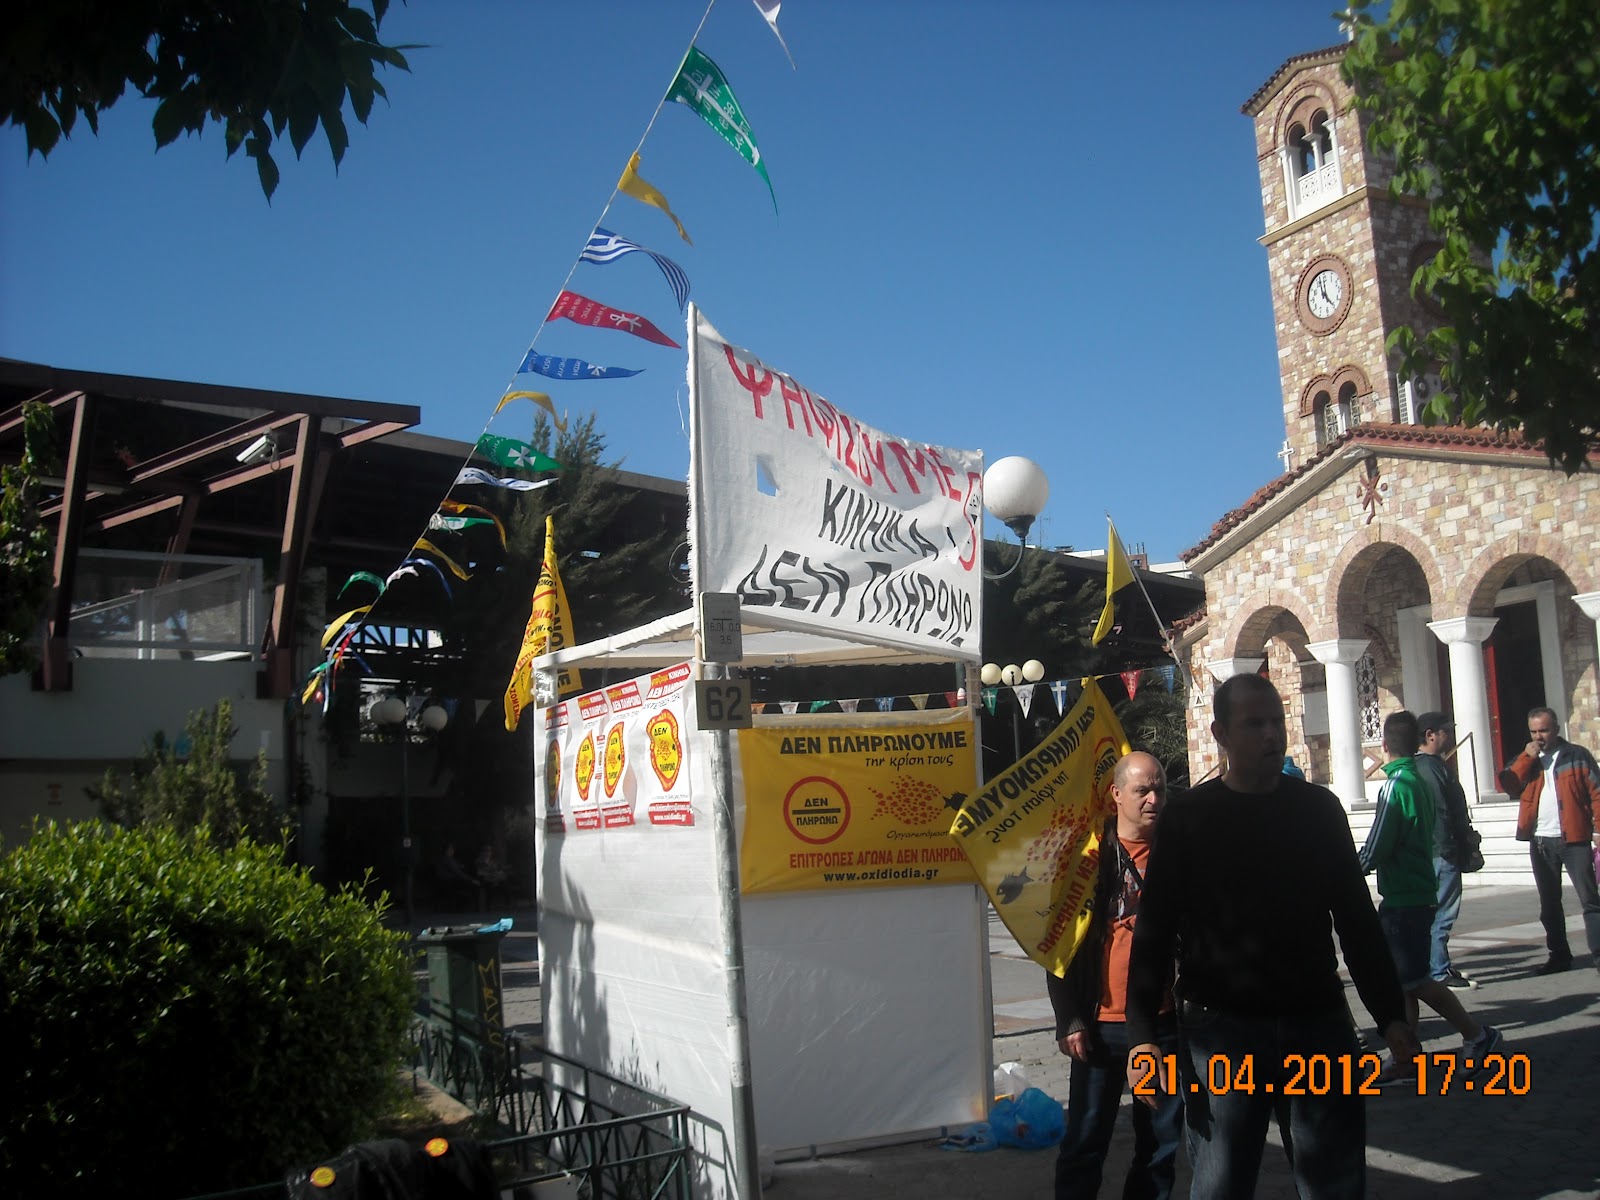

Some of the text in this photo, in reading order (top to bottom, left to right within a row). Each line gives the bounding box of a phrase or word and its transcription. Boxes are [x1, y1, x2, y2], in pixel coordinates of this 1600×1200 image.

[818, 478, 939, 561] ΚΙΝΗΜΑ
[737, 544, 850, 617] ΔΕΝ
[705, 686, 743, 721] 62
[780, 730, 967, 755] ΔΕΝ ΠΛΗΡΩΝΟΥΜΕ
[890, 752, 924, 772] κρίση
[928, 754, 954, 767] τους
[804, 797, 829, 807] ΔΕΝ
[796, 816, 838, 826] ΠΛΗΡΩΝΩ
[789, 847, 968, 869] ΕΠΙΤΡΟΠΕΣ ΑΓΩΝΑ ΔΕΝ ΠΛΗΡΩΝ
[823, 867, 939, 882] www.oxidiodia.gr
